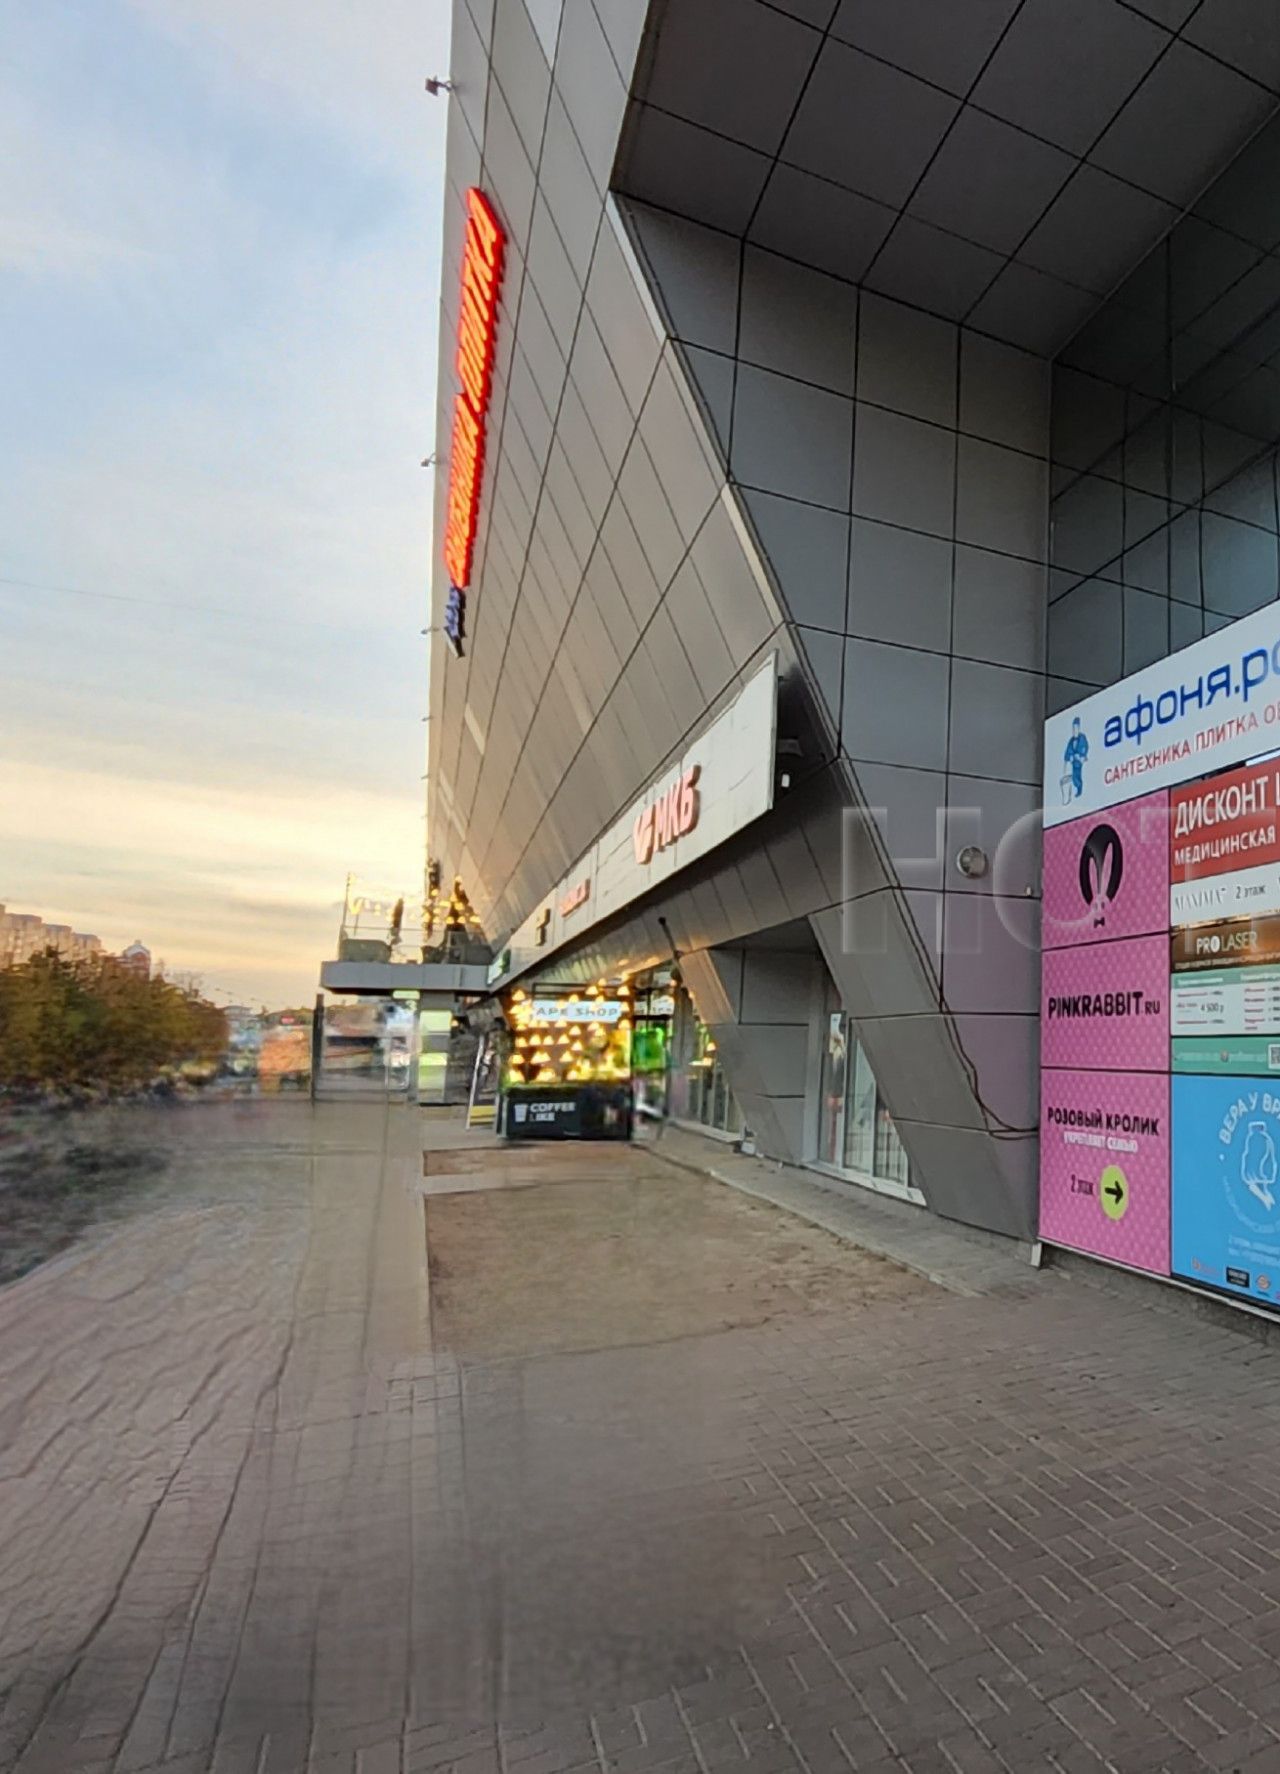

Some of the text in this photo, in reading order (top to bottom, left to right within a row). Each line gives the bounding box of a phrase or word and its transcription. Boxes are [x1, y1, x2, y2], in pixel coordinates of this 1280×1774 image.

[1104, 740, 1191, 785] САНТЕХНИКА
[1195, 713, 1258, 752] ПЛИТКА
[1174, 775, 1269, 838] ДИСКОНТ
[1174, 824, 1276, 865] МЕДИЦИНСКАЯ
[530, 1101, 577, 1113] COFFEE
[1047, 1107, 1160, 1137] РОЗОВЫЙ КРОЛИК
[1219, 1099, 1249, 1144] ВЕРА
